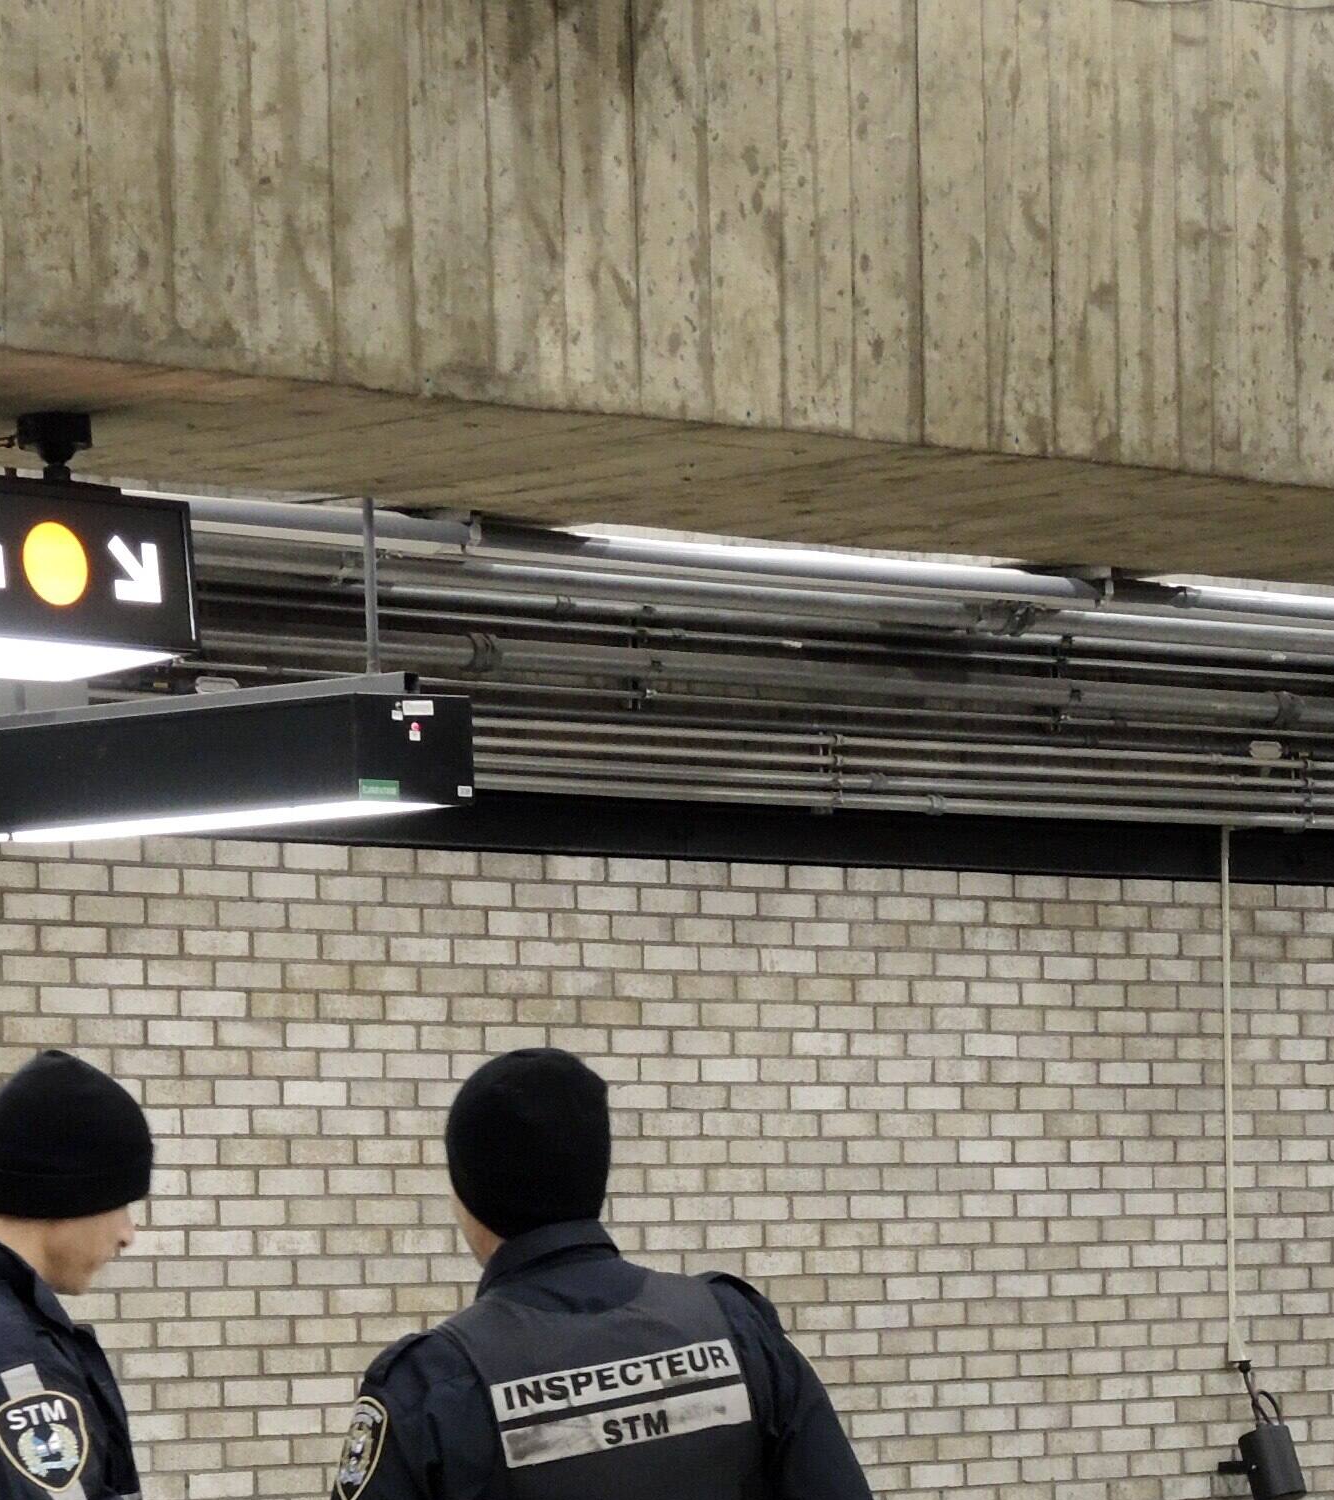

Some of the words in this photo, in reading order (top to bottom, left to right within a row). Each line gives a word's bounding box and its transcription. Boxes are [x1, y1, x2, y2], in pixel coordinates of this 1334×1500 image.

[503, 1344, 731, 1411] INSPECTEUR
[6, 1399, 67, 1431] STM
[602, 1408, 670, 1445] STM
